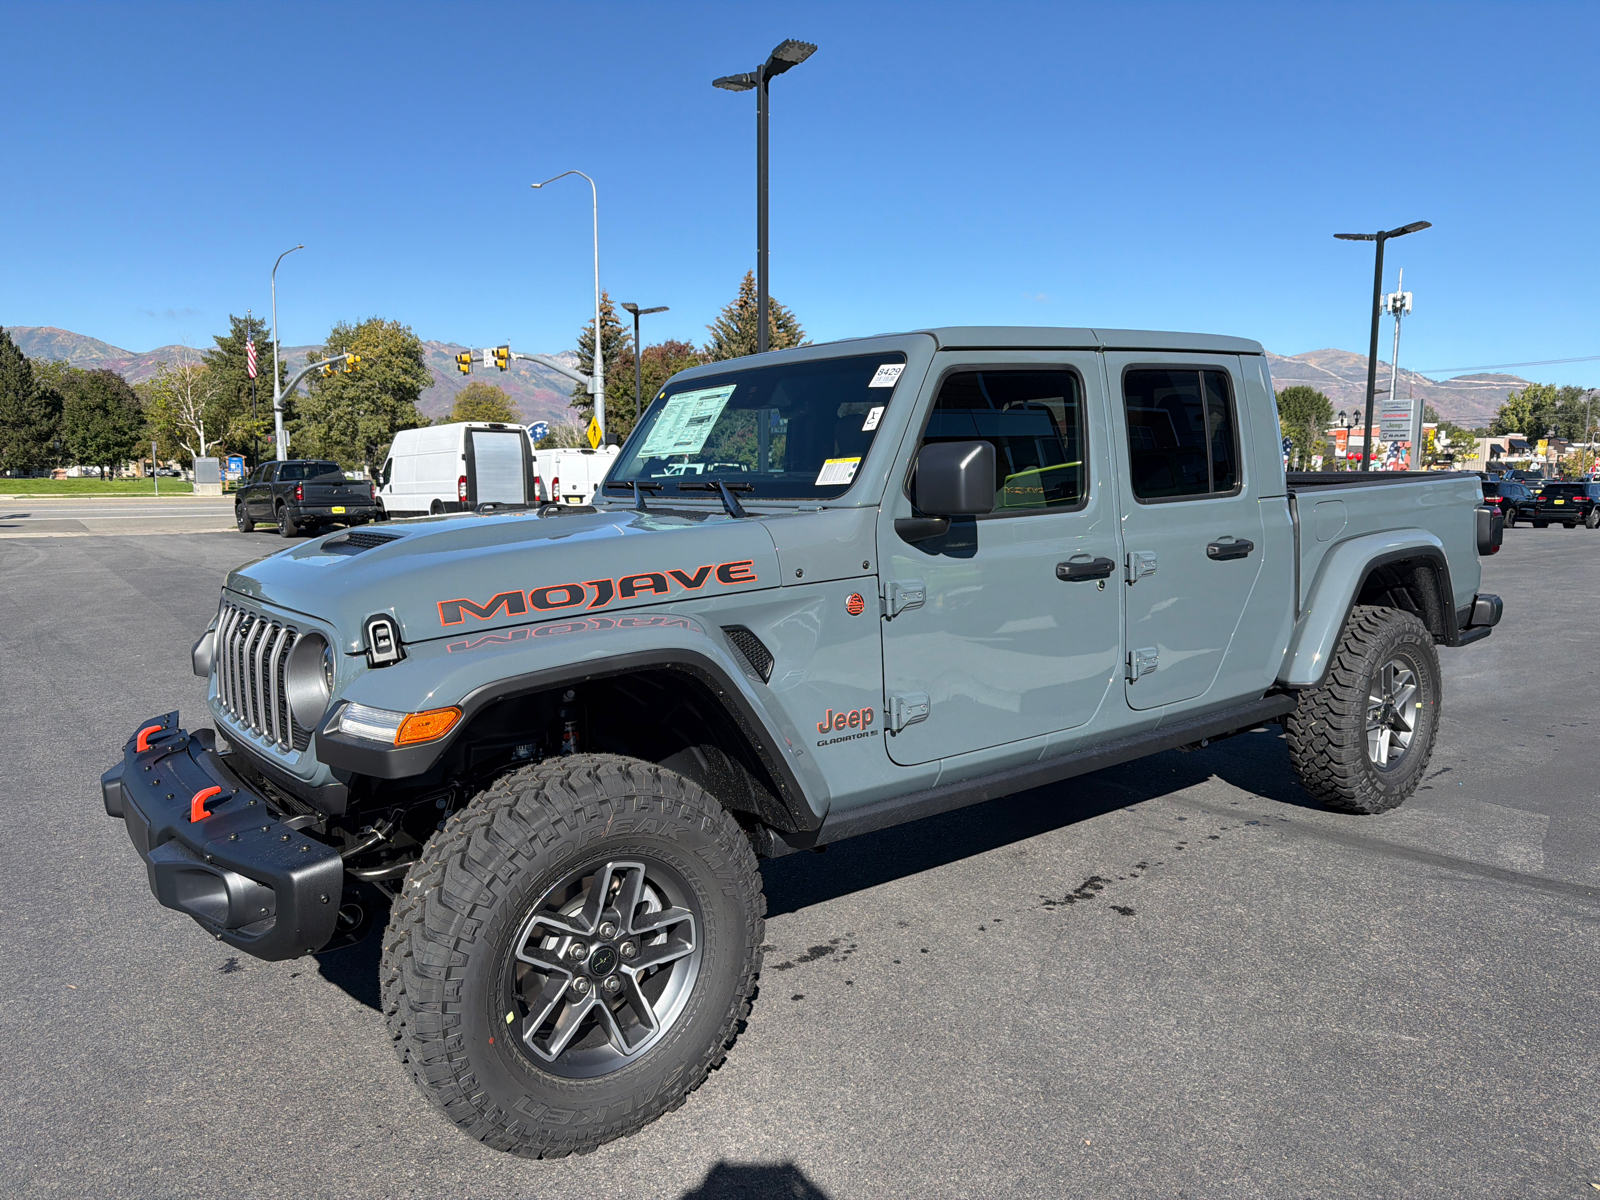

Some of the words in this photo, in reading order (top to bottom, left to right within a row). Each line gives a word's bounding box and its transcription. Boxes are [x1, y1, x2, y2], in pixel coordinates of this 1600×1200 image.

[877, 367, 902, 376] 8429
[437, 559, 757, 627] MOJAVE
[816, 706, 874, 735] Jeep
[816, 731, 869, 747] GLADIATOR
